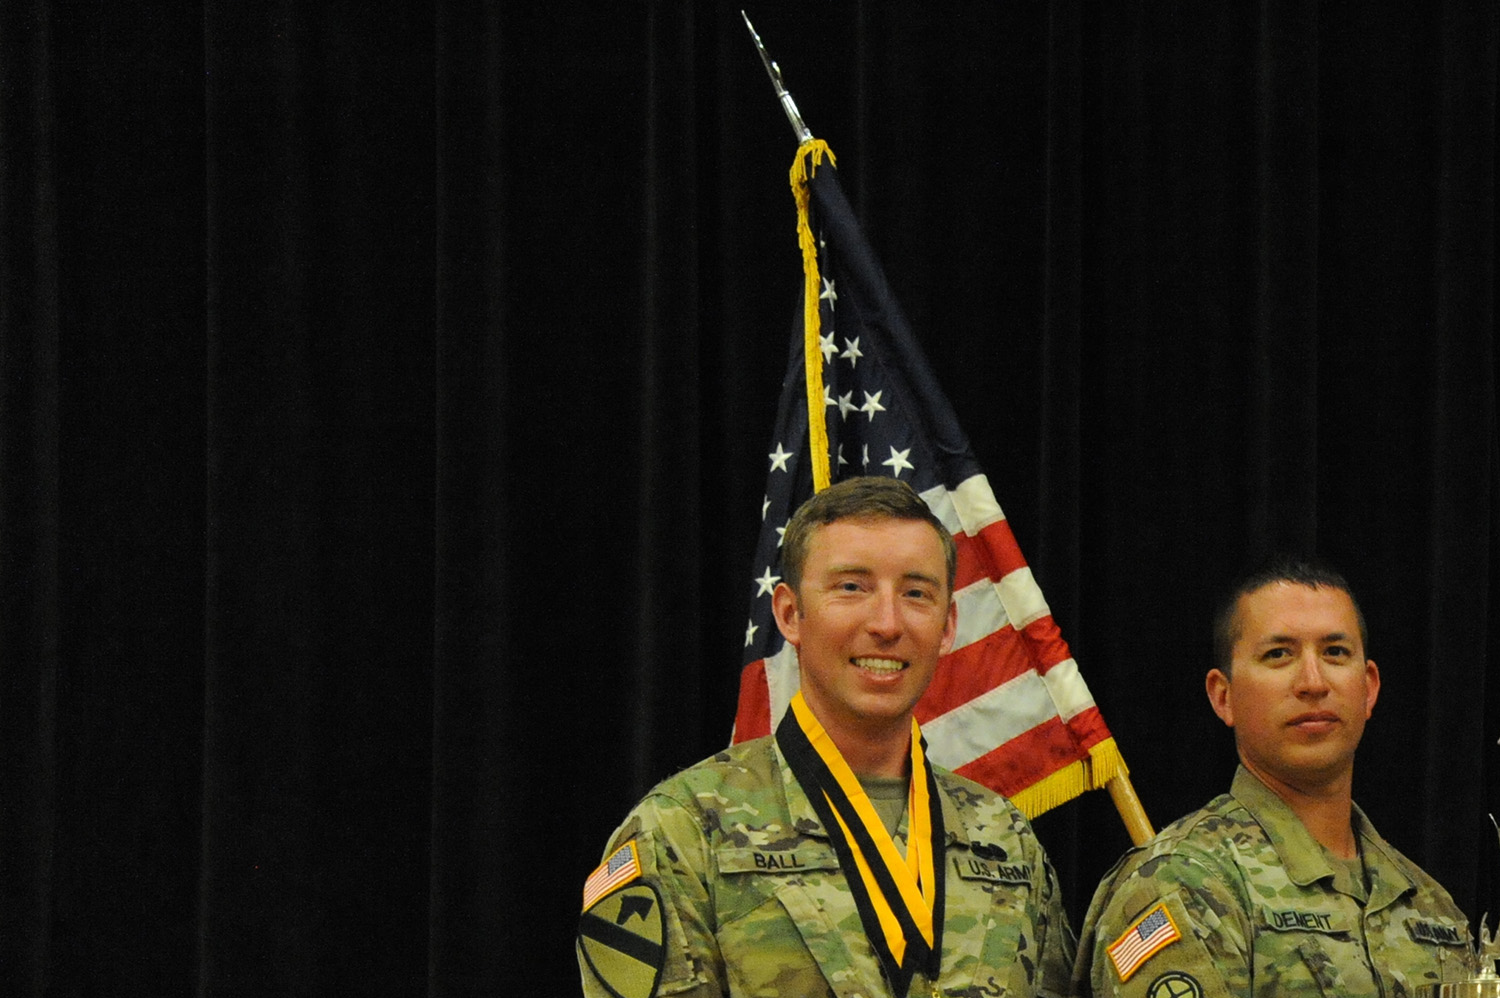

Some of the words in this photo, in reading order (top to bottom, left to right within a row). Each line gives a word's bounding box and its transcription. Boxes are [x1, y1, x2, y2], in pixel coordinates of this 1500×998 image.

[753, 852, 805, 869] BALL
[968, 860, 996, 878] U.S.
[1272, 911, 1331, 929] DEMENT
